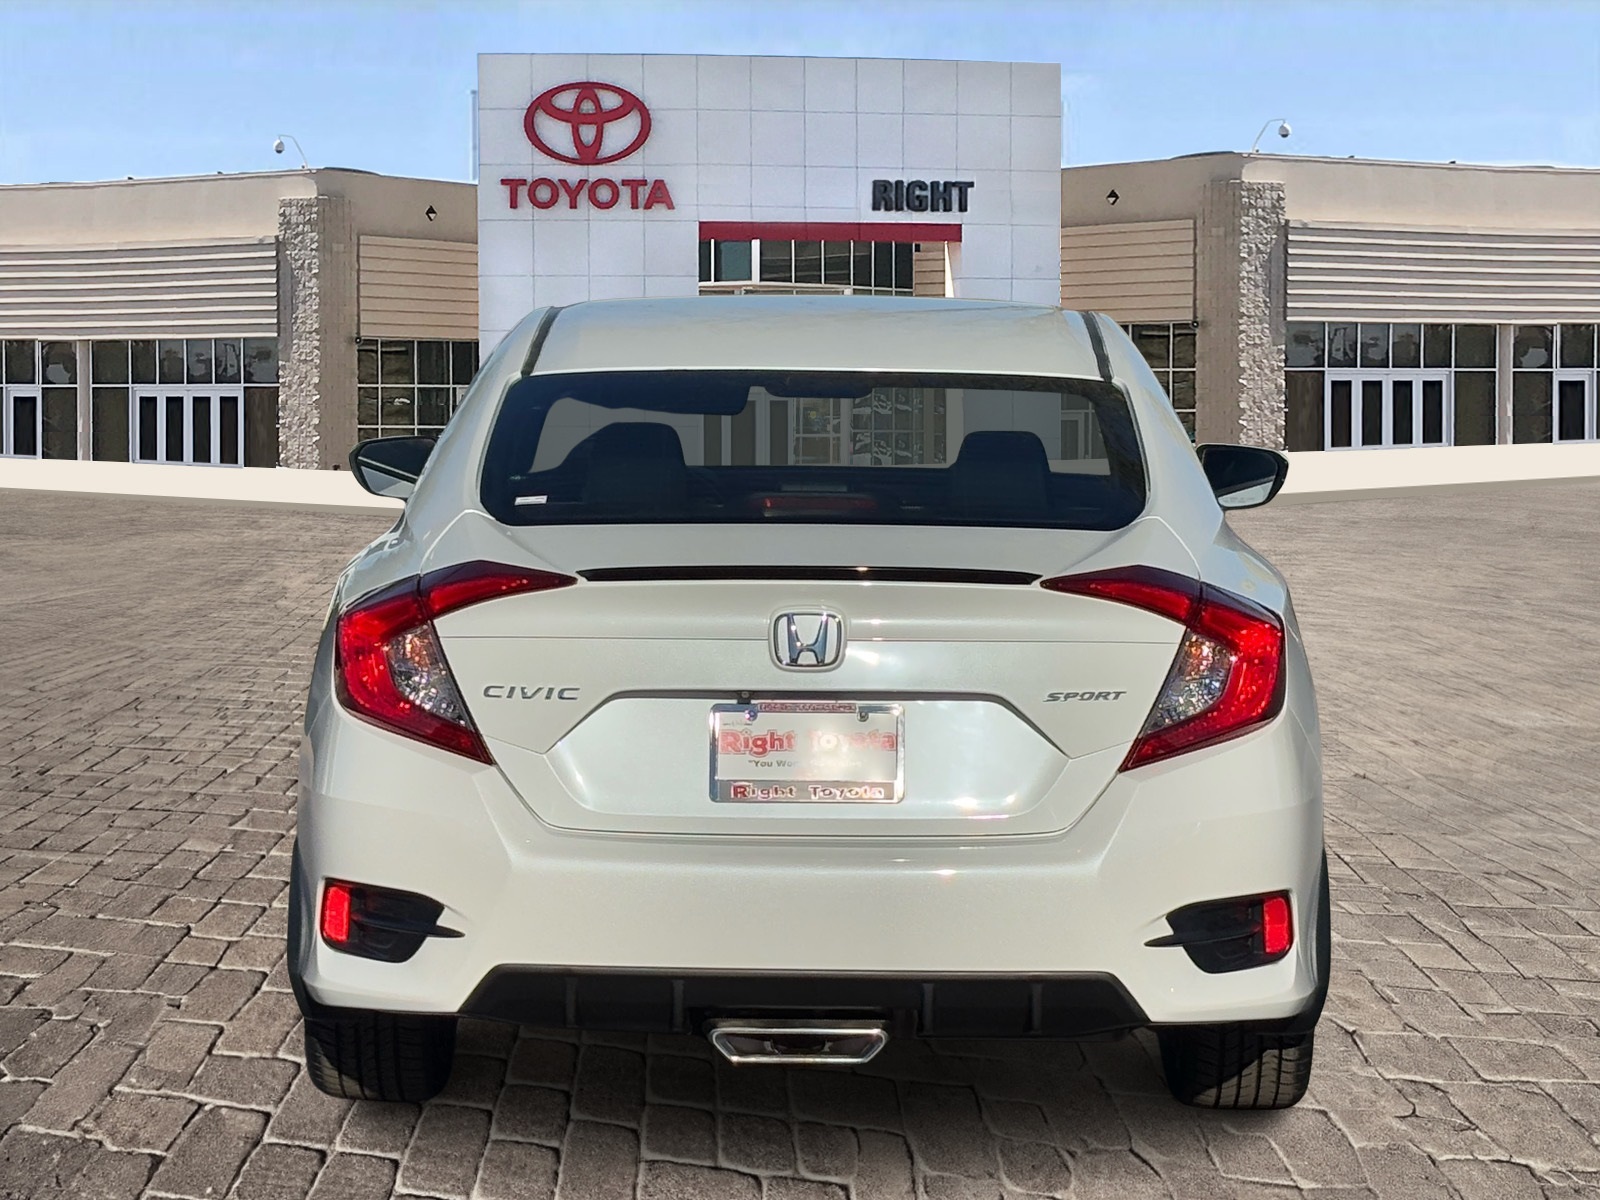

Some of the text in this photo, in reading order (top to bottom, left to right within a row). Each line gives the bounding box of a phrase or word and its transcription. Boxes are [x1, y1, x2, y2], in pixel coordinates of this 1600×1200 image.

[500, 178, 675, 210] TOYOTA
[871, 179, 975, 213] RIGHT
[483, 685, 581, 701] CIVIC
[1042, 691, 1128, 703] SPORT
[719, 729, 796, 757] Right
[731, 781, 885, 800] Right Toyota
